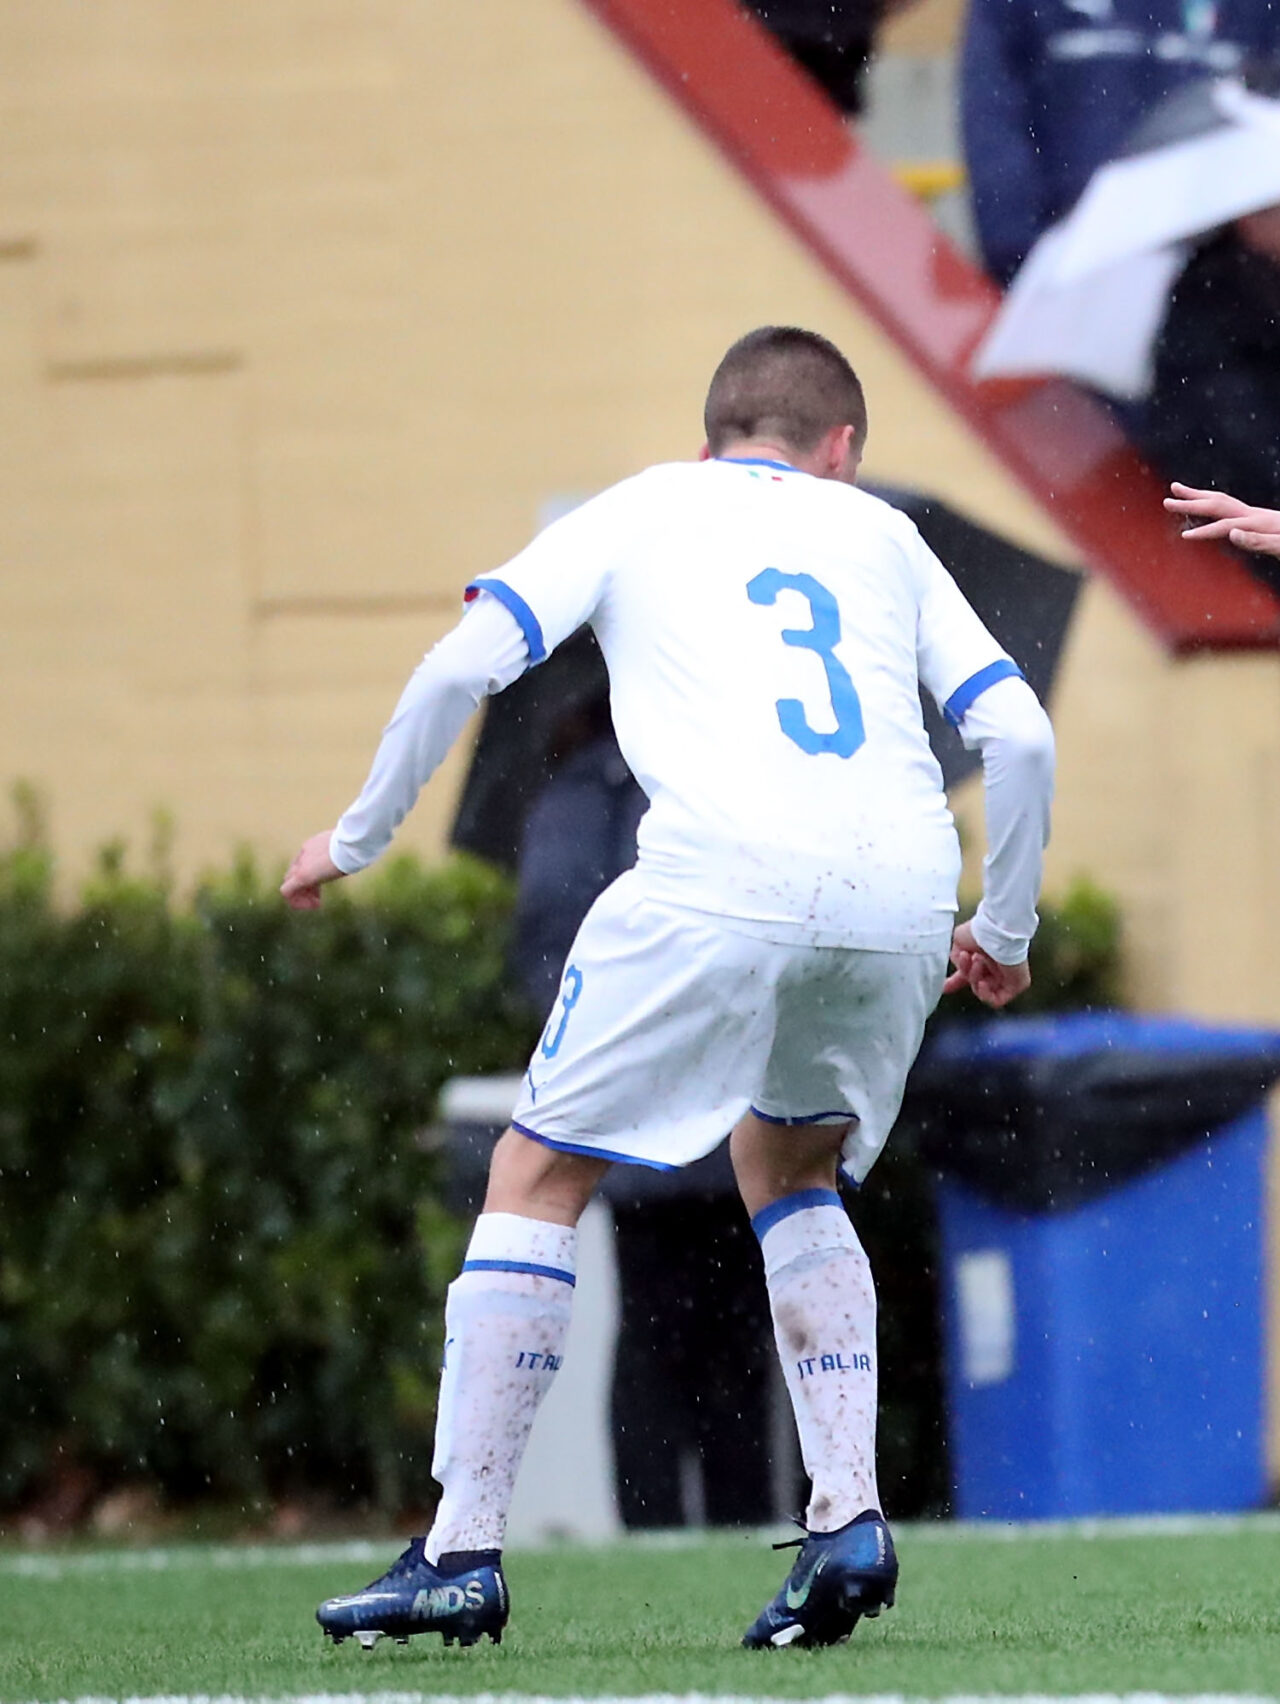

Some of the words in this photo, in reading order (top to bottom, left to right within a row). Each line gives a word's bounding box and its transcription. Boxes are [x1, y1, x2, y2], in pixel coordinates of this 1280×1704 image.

[745, 566, 867, 760] 3
[541, 963, 584, 1061] 3
[515, 1351, 564, 1372] ITAL
[797, 1353, 872, 1380] ITALIA
